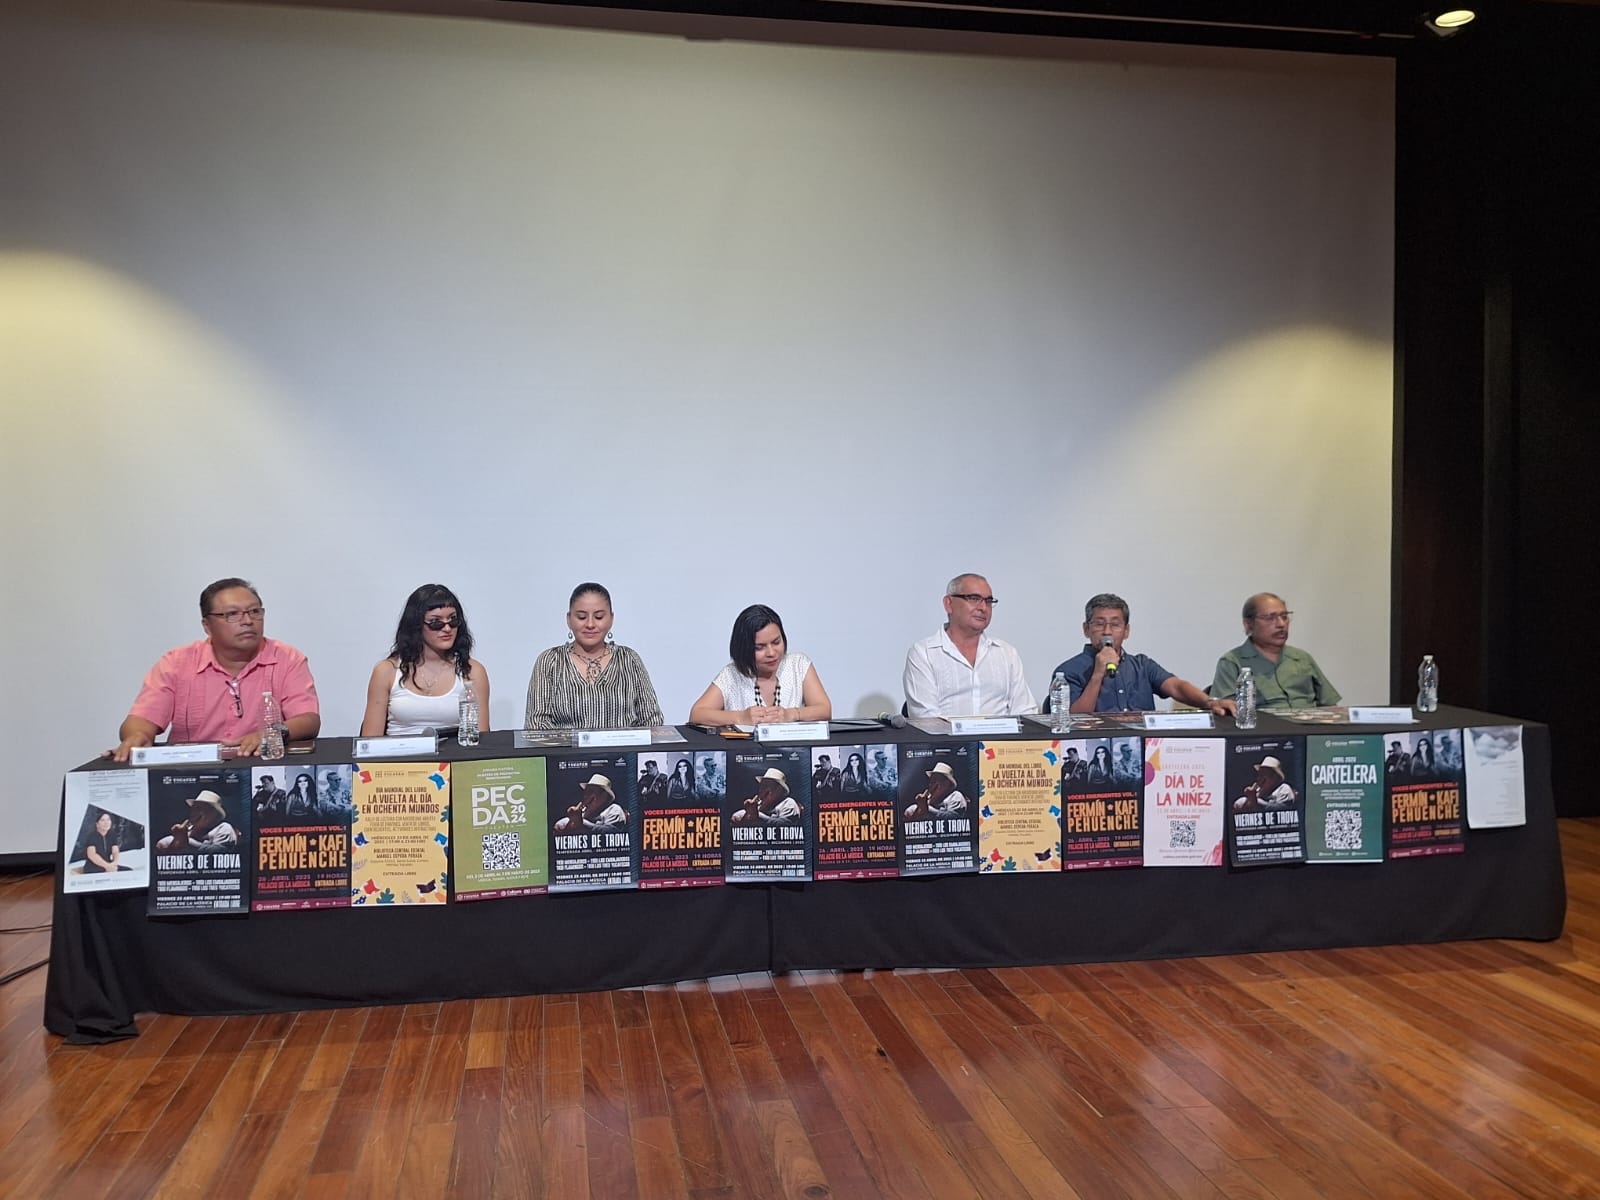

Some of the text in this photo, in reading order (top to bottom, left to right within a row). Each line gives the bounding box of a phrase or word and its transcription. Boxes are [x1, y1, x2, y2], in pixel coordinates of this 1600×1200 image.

[992, 768, 1046, 778] LA VUELTA AL DÍA
[1165, 772, 1204, 788] DÍA DE
[1311, 765, 1377, 784] CARTELERA
[988, 778, 1053, 788] EN OCHENTA MUNDOS
[368, 793, 432, 803] LA VUELTA AL DÍA
[472, 784, 525, 807] PEC
[1157, 792, 1172, 806] LA
[1392, 789, 1459, 808] FERMÍN KAFI
[362, 804, 439, 814] EN OCHENTA MUNDOS
[473, 806, 510, 826] DA
[511, 805, 525, 813] 20
[1067, 799, 1137, 817] FERMÍN KAFI
[1392, 804, 1460, 824] PEHUENCHE
[511, 814, 526, 823] 24
[644, 815, 720, 834] FERMÍN KAFI
[819, 808, 893, 827] FERMÍN KAFI
[1068, 814, 1139, 833] PEHUENCHE
[1234, 810, 1299, 827] VIERNES DE TROVA
[732, 826, 804, 840] VIERNES DE TROVA
[819, 825, 894, 842] PEHUENCHE
[905, 819, 970, 835] VIERNES DE TROVA
[259, 833, 346, 853] FERMÍN KAFI
[555, 833, 630, 849] VIERNES DE TROVA
[643, 832, 720, 850] PEHUENCHE
[157, 854, 240, 870] VIERNES DE TROVA
[259, 851, 346, 870] PEHUENCHE
